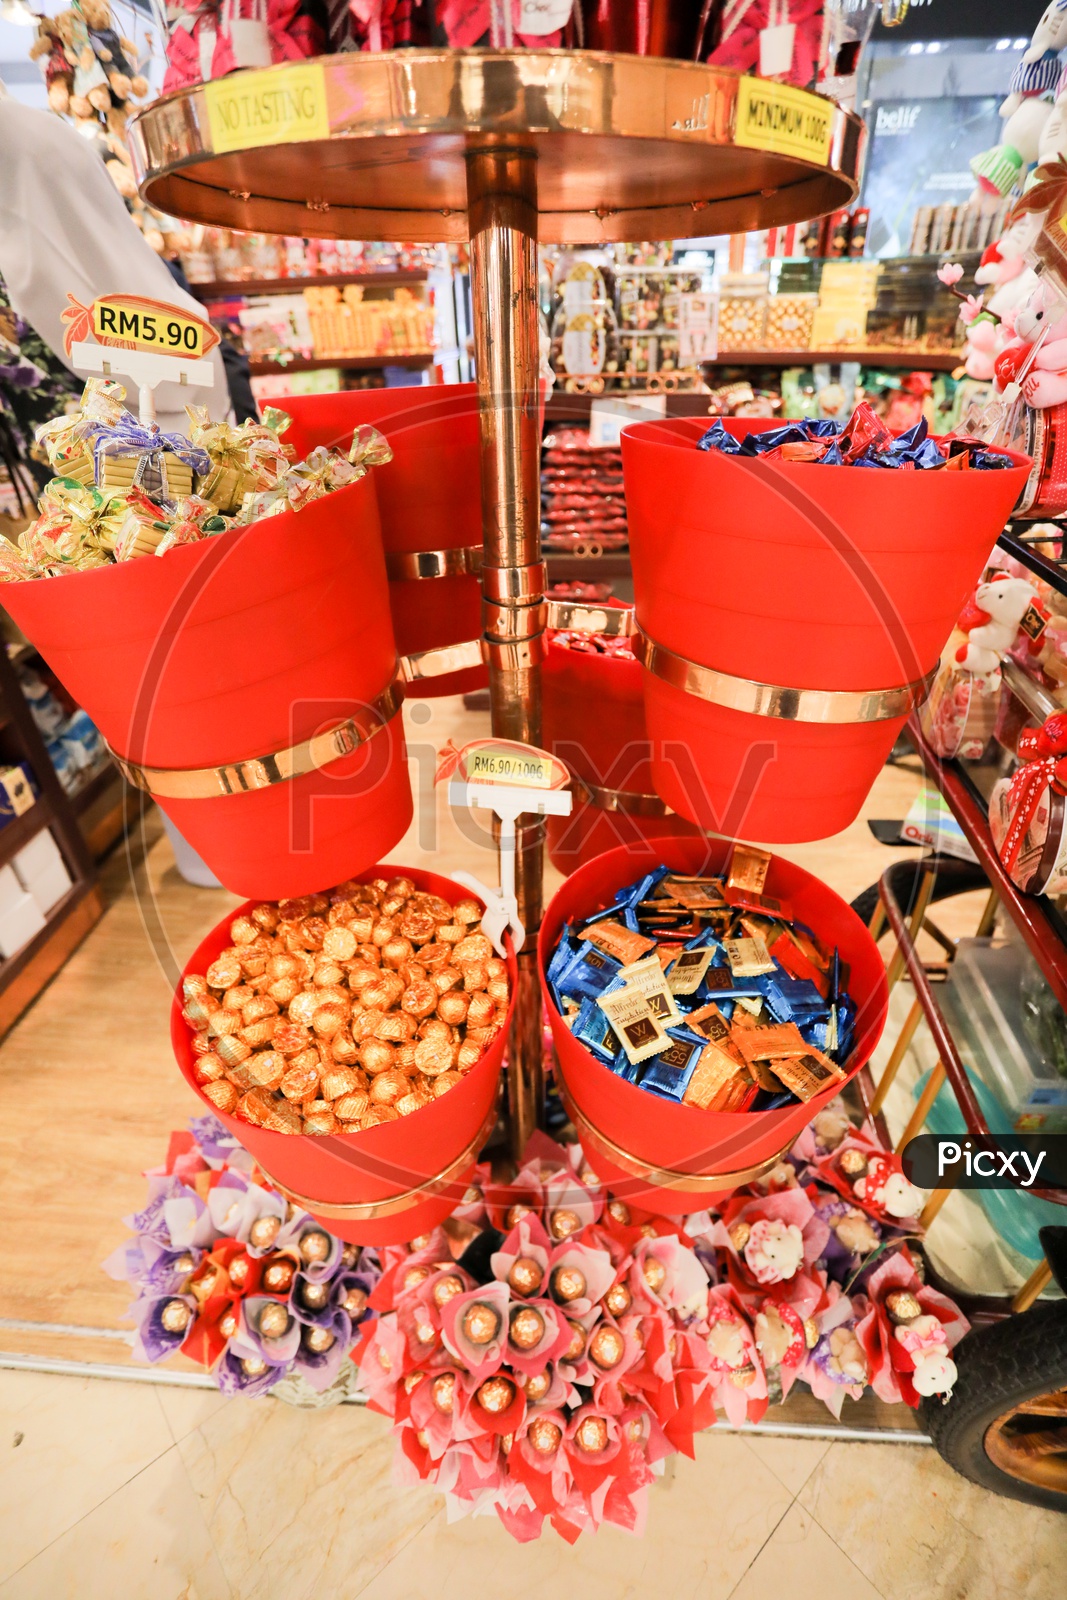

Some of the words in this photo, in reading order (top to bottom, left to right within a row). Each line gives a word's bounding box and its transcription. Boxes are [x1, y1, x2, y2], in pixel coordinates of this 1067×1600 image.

[217, 98, 240, 132] NO
[241, 86, 316, 128] TASTING
[747, 99, 803, 136] MINIMUM
[804, 115, 827, 144] 100G
[99, 306, 198, 350] RM5.90
[474, 756, 543, 780] RM6.90/100G
